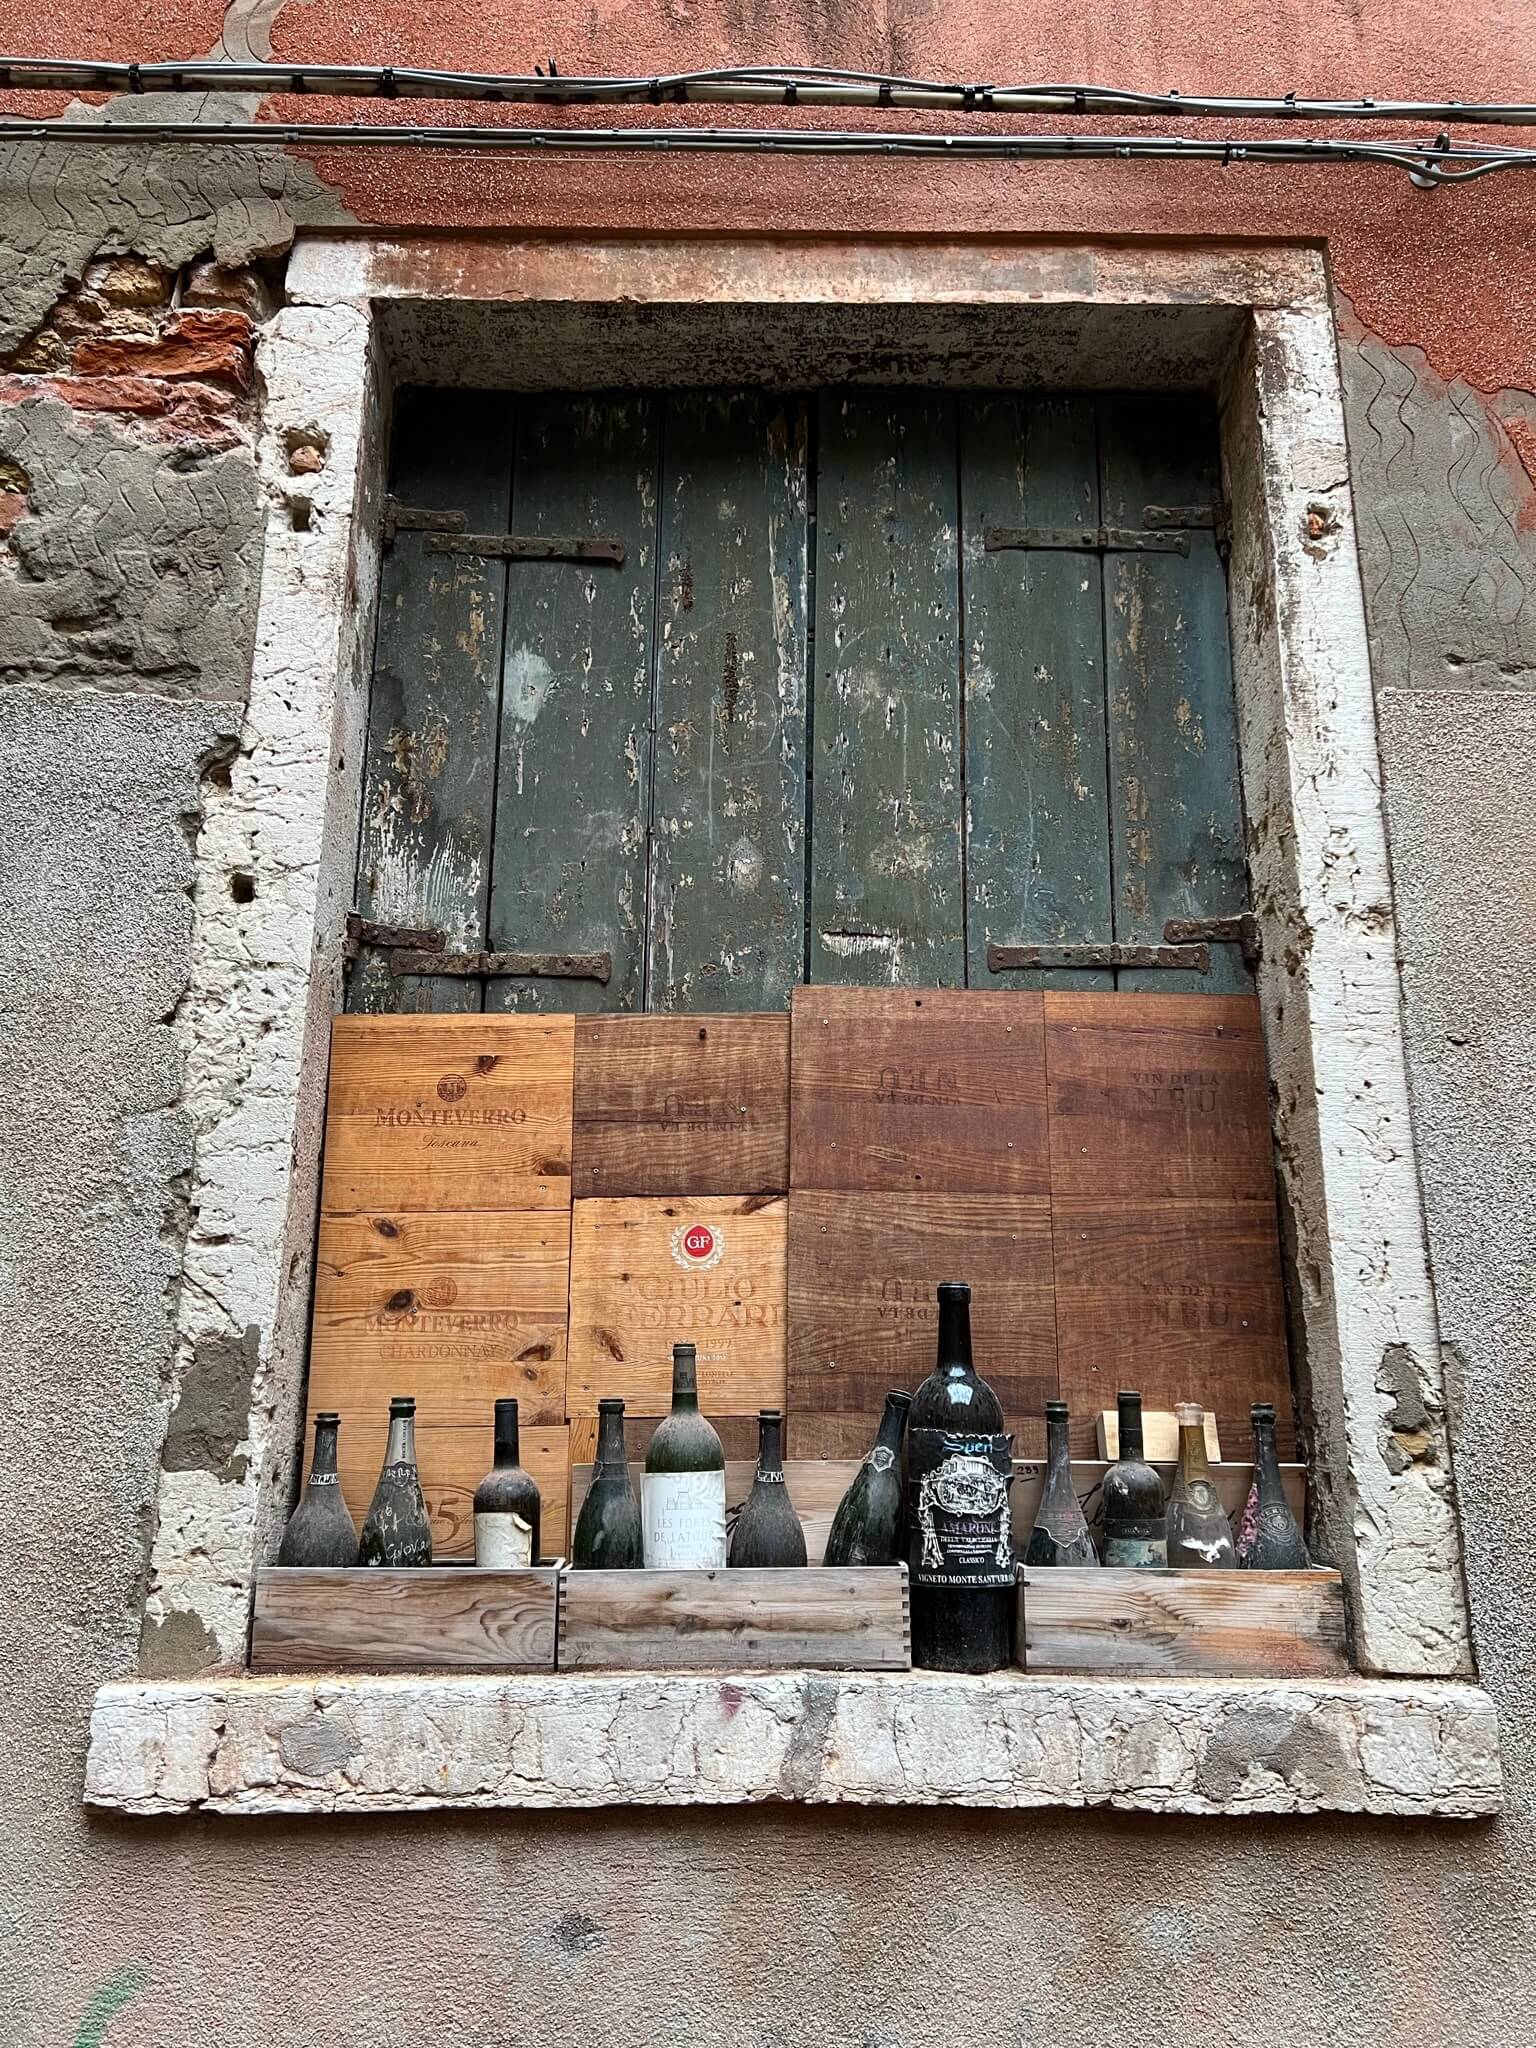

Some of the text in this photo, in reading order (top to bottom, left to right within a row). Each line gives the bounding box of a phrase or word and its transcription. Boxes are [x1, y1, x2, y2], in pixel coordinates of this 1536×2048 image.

[376, 1107, 527, 1128] MONTEVERRO
[416, 1134, 479, 1151] Toscana
[686, 1235, 711, 1249] GF
[638, 1275, 757, 1301] GIULIO
[379, 1343, 499, 1360] CHARDONNAY
[657, 1518, 711, 1529] LES FORTS
[654, 1531, 665, 1543] DE
[958, 1556, 985, 1564] CLASSICO
[918, 1573, 948, 1584] VIGNETO
[948, 1575, 977, 1585] MONTE
